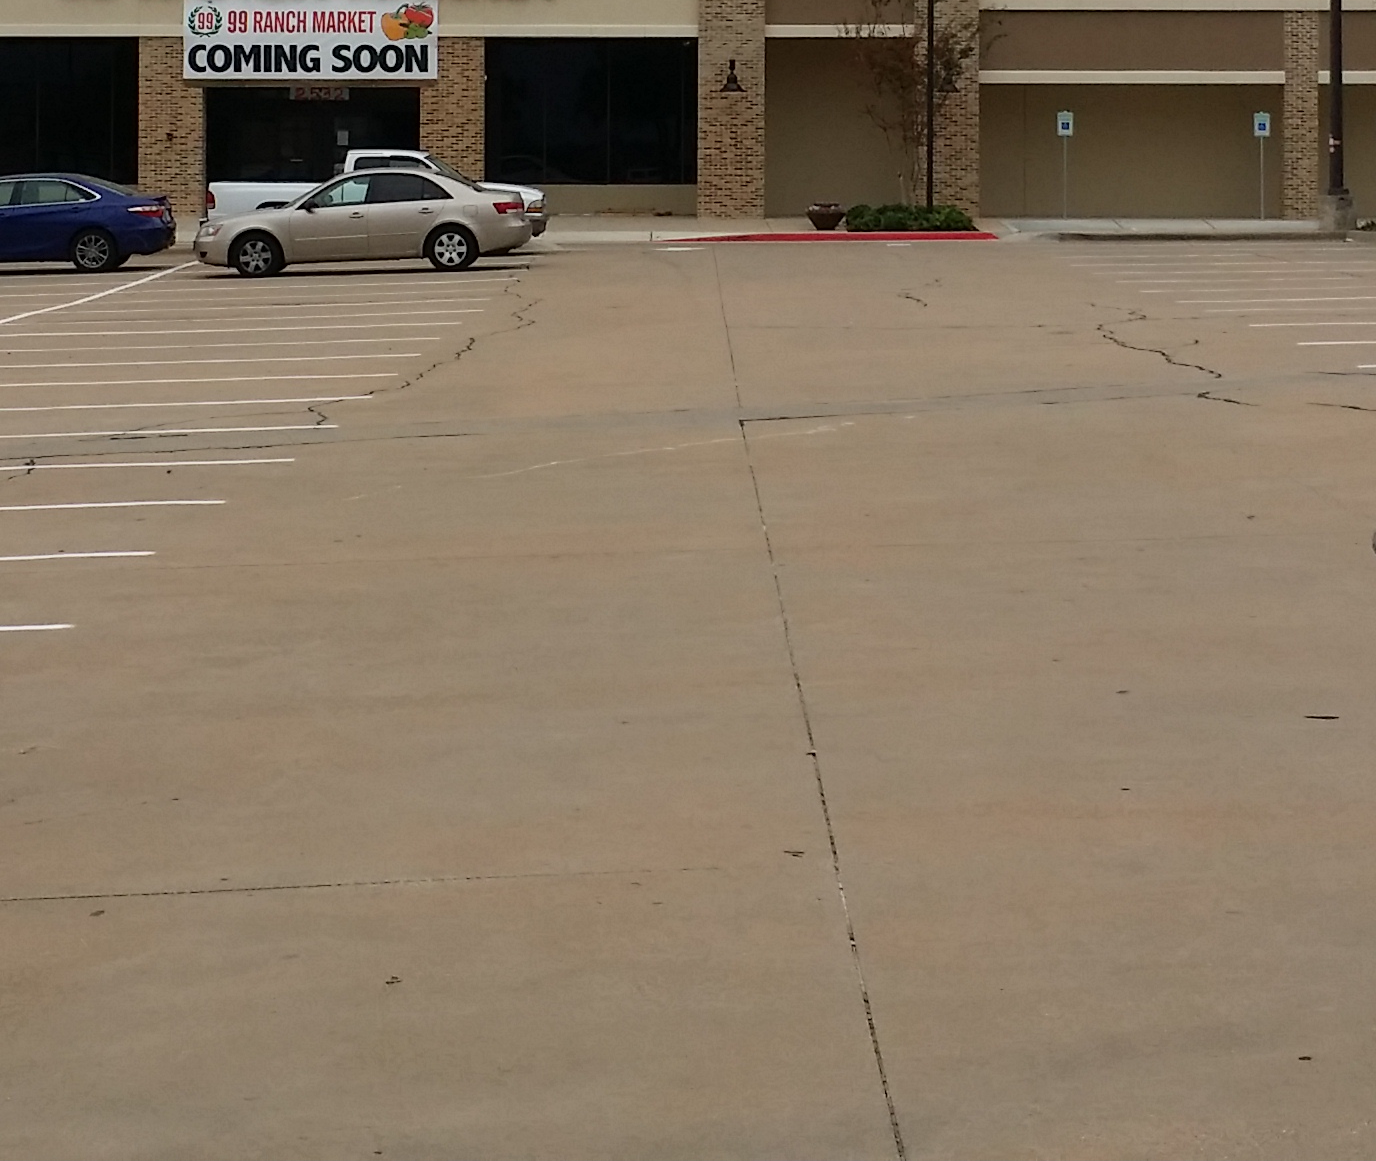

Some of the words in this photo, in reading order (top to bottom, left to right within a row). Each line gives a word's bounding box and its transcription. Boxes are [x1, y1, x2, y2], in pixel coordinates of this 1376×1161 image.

[197, 12, 214, 30] 99
[227, 10, 248, 34] 99
[253, 11, 307, 34] RANCH
[312, 11, 376, 33] MARKET
[188, 44, 321, 73] COMING
[331, 44, 429, 73] SOON
